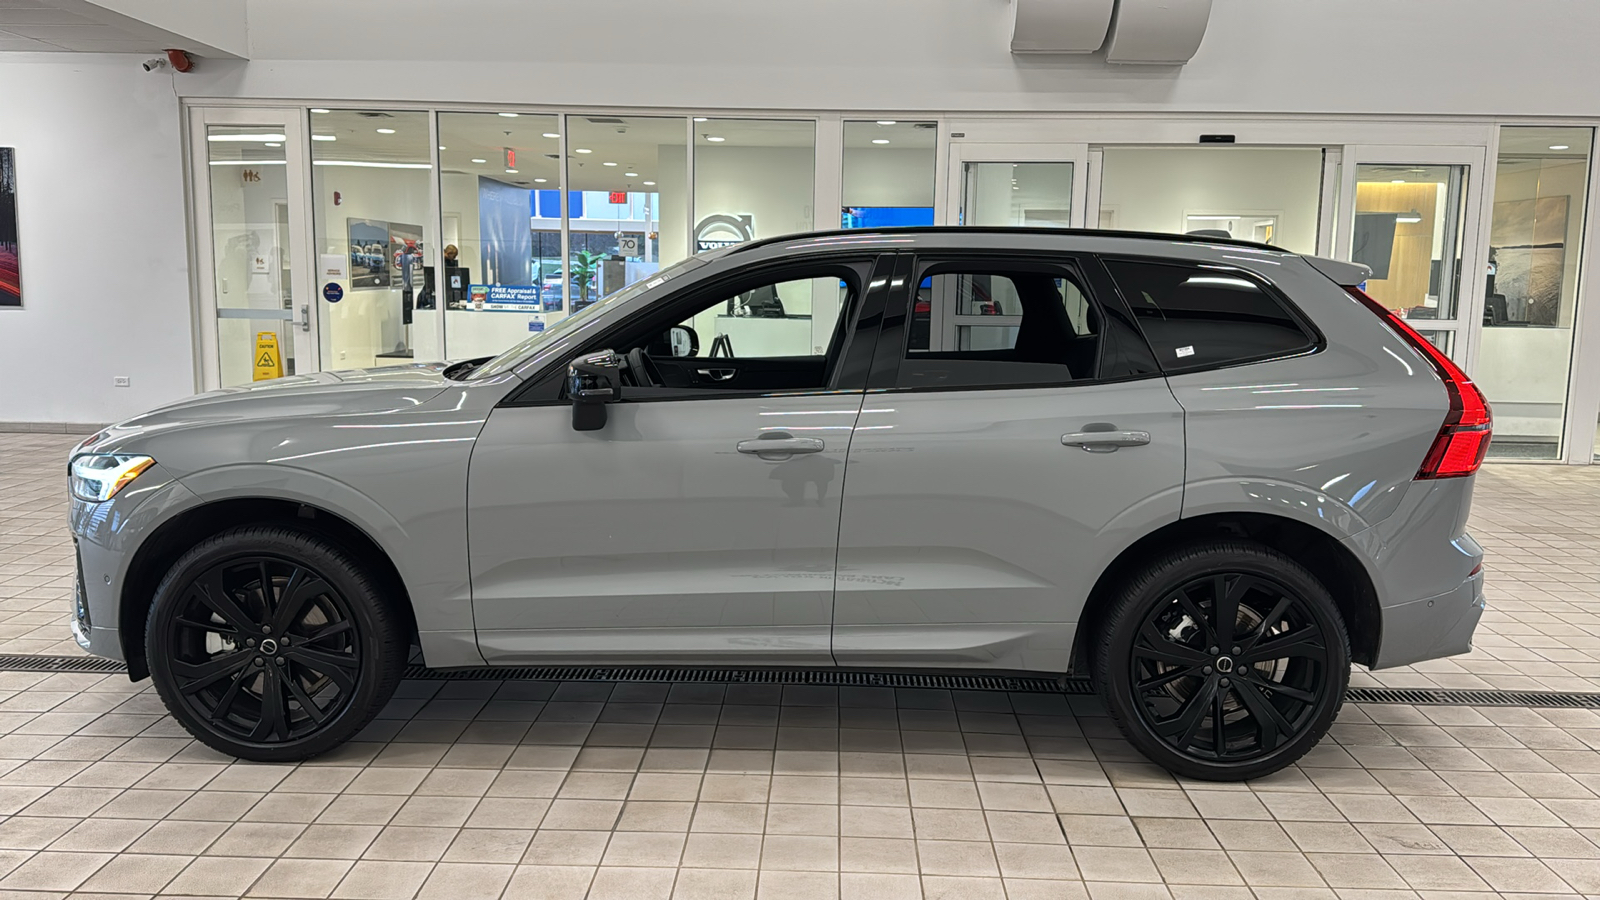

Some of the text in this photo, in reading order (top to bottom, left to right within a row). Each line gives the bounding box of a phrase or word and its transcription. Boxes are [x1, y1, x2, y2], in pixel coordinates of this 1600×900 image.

[621, 239, 636, 249] 70
[507, 287, 532, 295] Appraisal
[517, 293, 537, 301] Report
